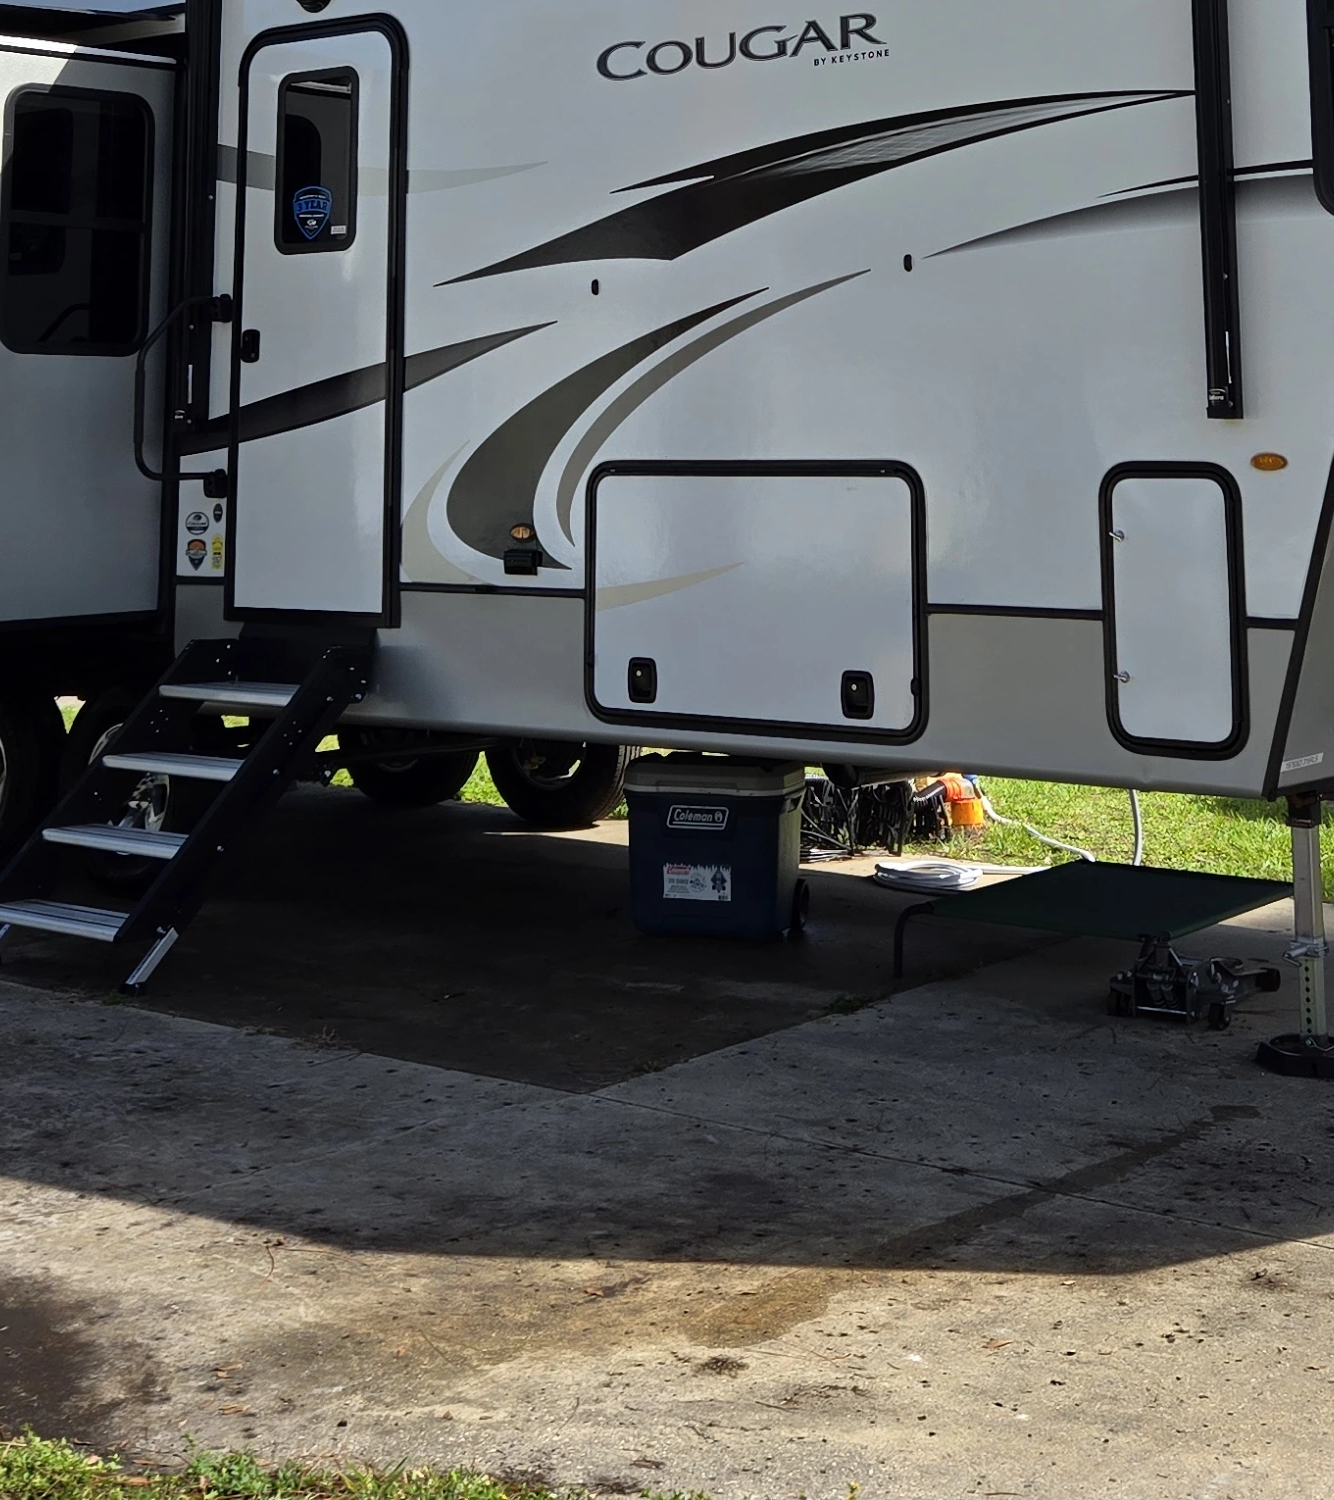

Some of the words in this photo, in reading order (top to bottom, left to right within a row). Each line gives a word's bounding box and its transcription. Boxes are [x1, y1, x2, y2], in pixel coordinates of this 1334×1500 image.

[596, 12, 887, 82] COUGAR
[814, 58, 826, 67] BY
[831, 49, 890, 64] KEYSTONE
[296, 203, 303, 212] 3
[304, 200, 328, 211] YEAR
[673, 809, 713, 822] Coleman
